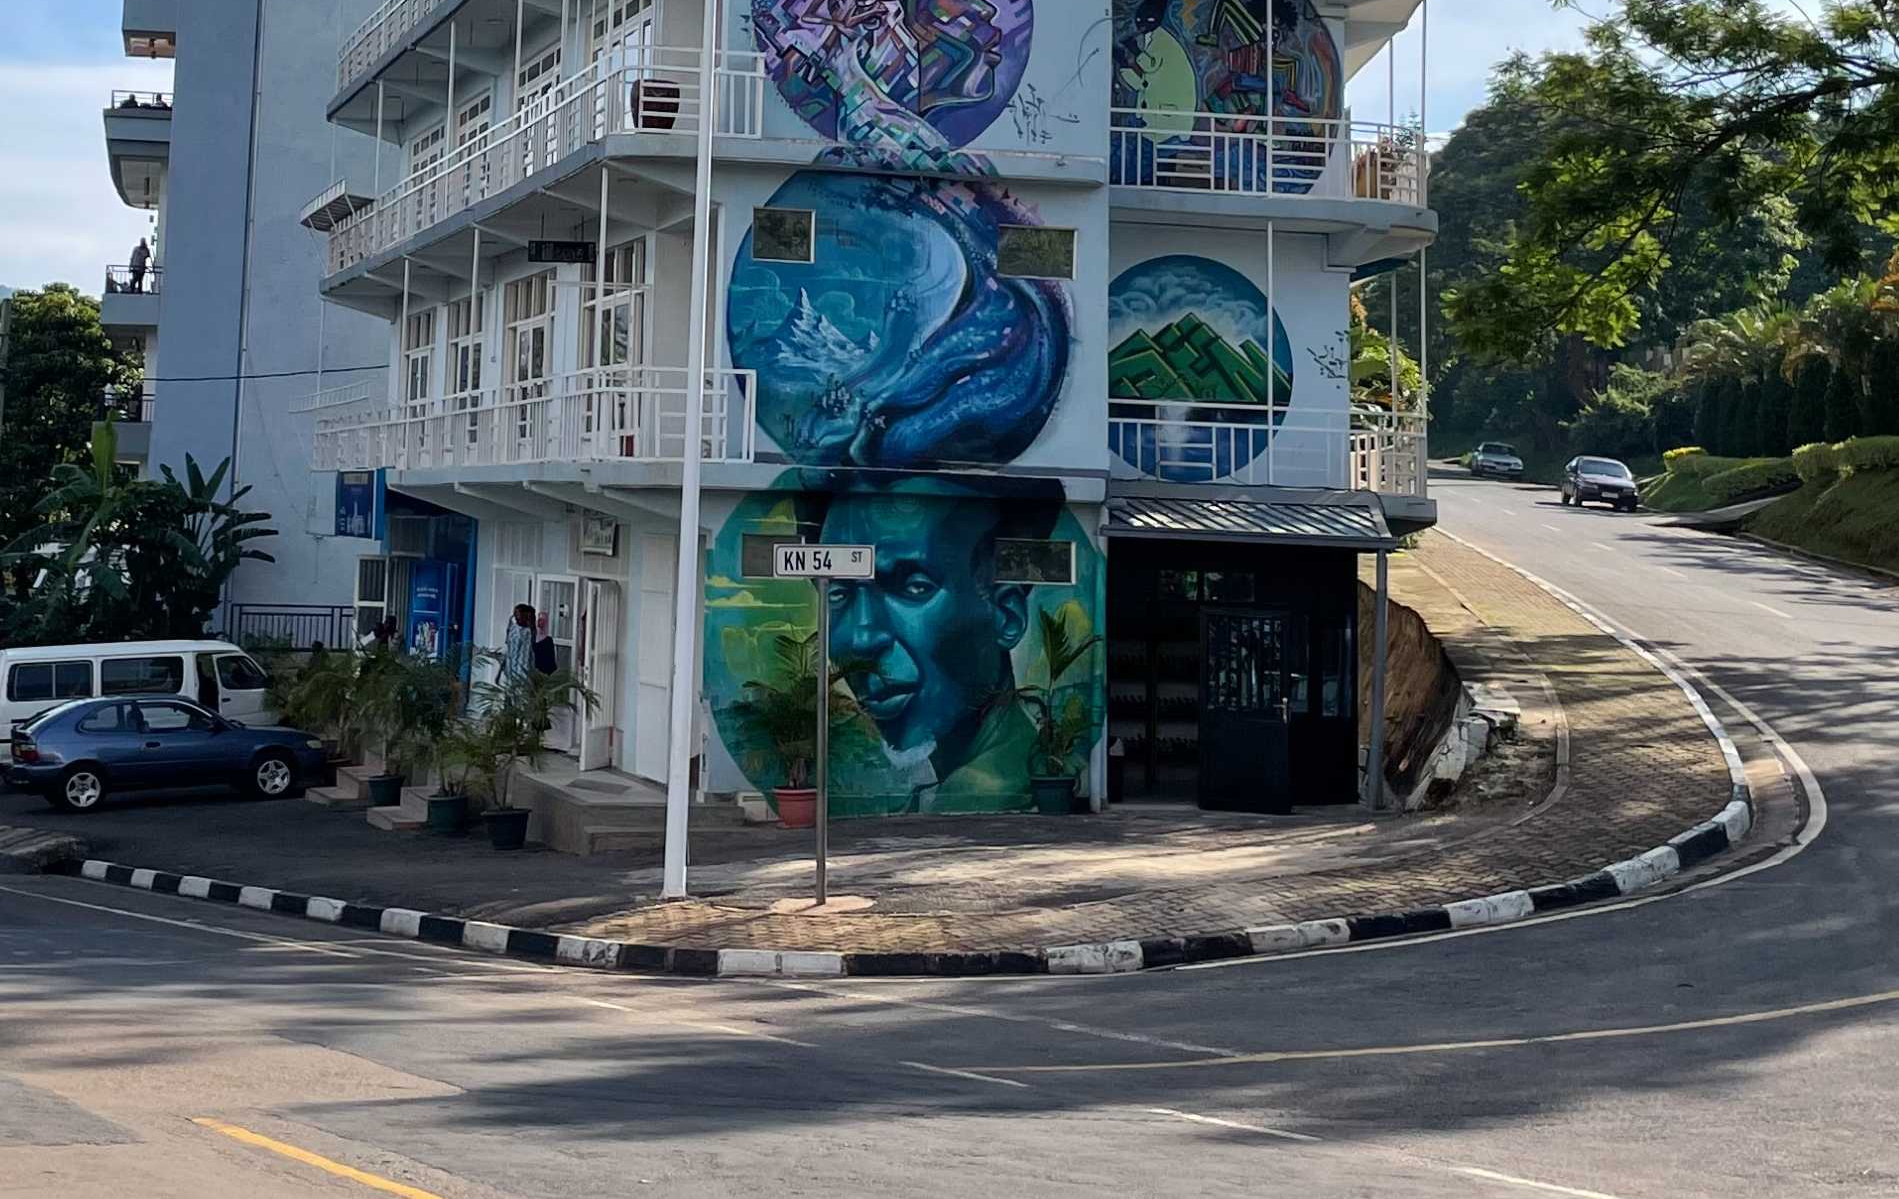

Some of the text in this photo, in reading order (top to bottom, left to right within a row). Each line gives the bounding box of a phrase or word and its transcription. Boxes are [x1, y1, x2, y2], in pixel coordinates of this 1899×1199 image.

[783, 550, 863, 571] KN 54 ST
